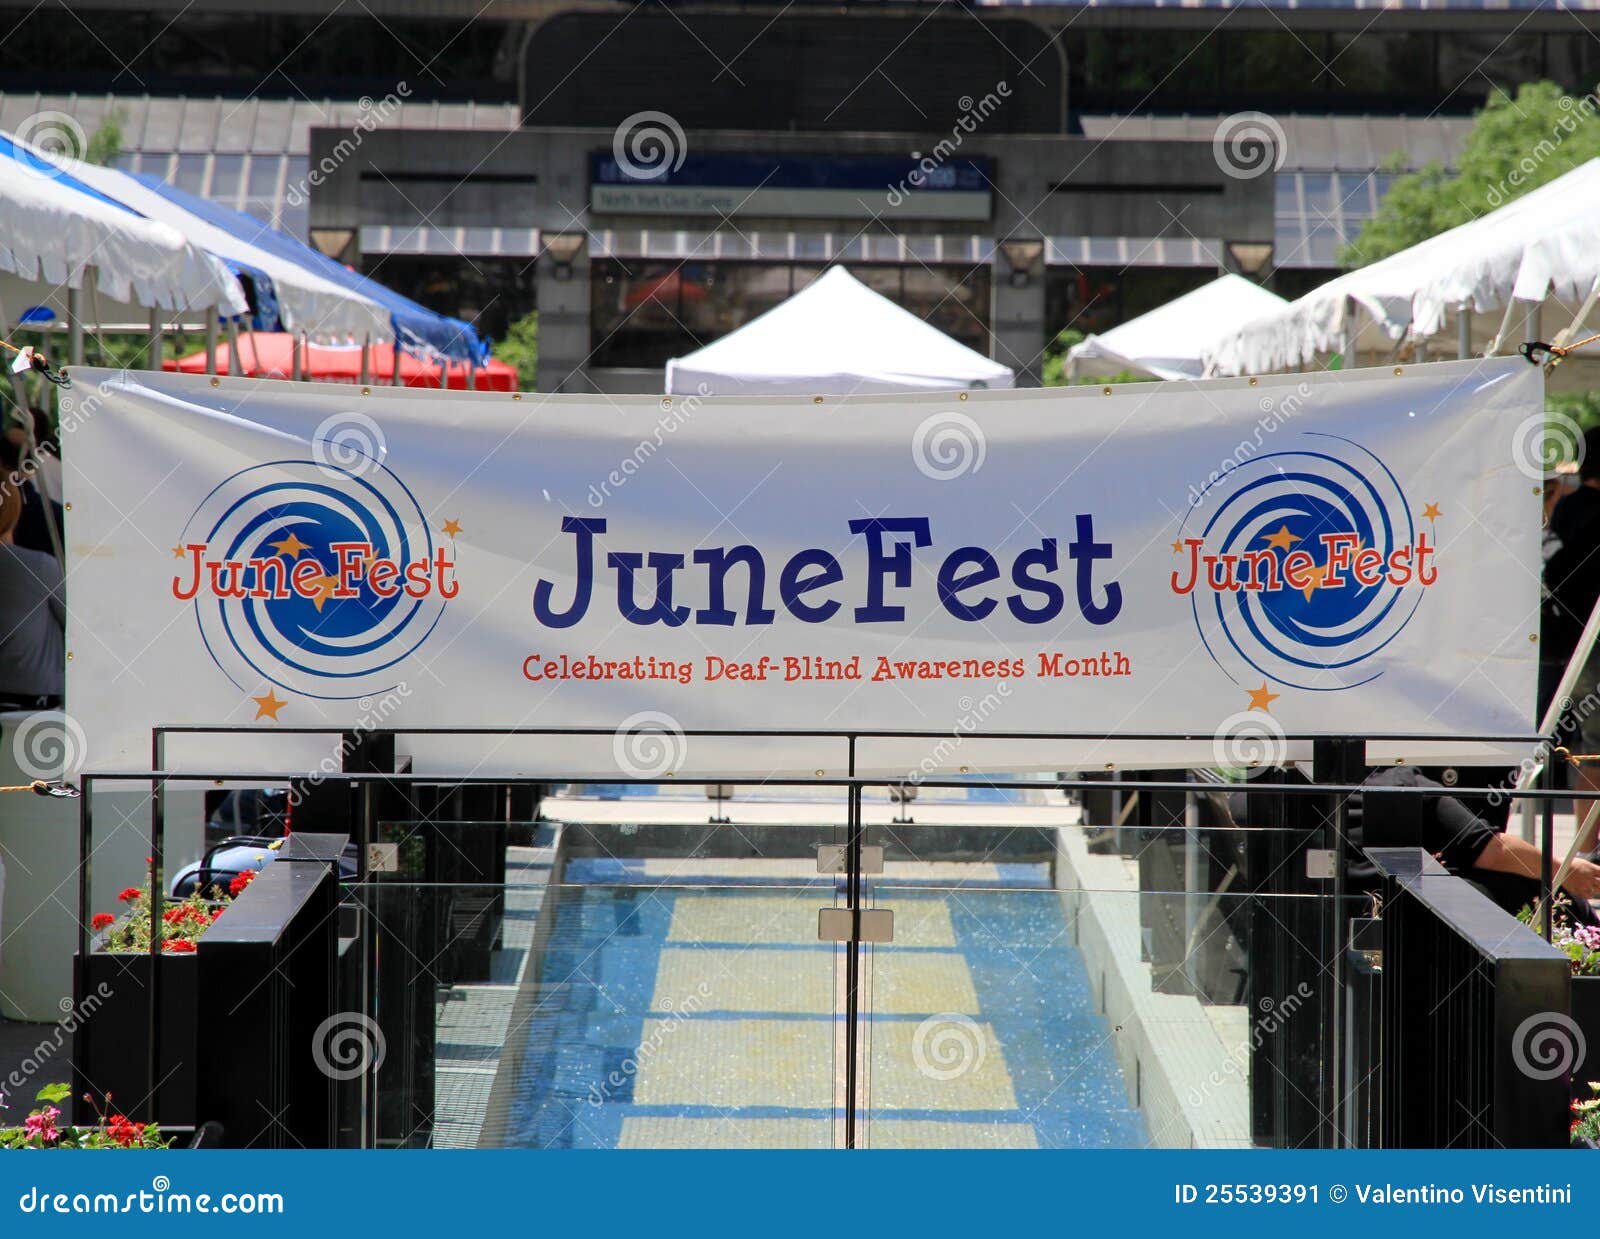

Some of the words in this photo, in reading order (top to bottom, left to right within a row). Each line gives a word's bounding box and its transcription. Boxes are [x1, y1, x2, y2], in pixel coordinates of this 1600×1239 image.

[533, 514, 1123, 628] JuneFest
[523, 655, 693, 684] Celebrating
[705, 656, 862, 682] Deaf-Blind
[872, 657, 1026, 682] Awareness
[1037, 652, 1132, 677] Month
